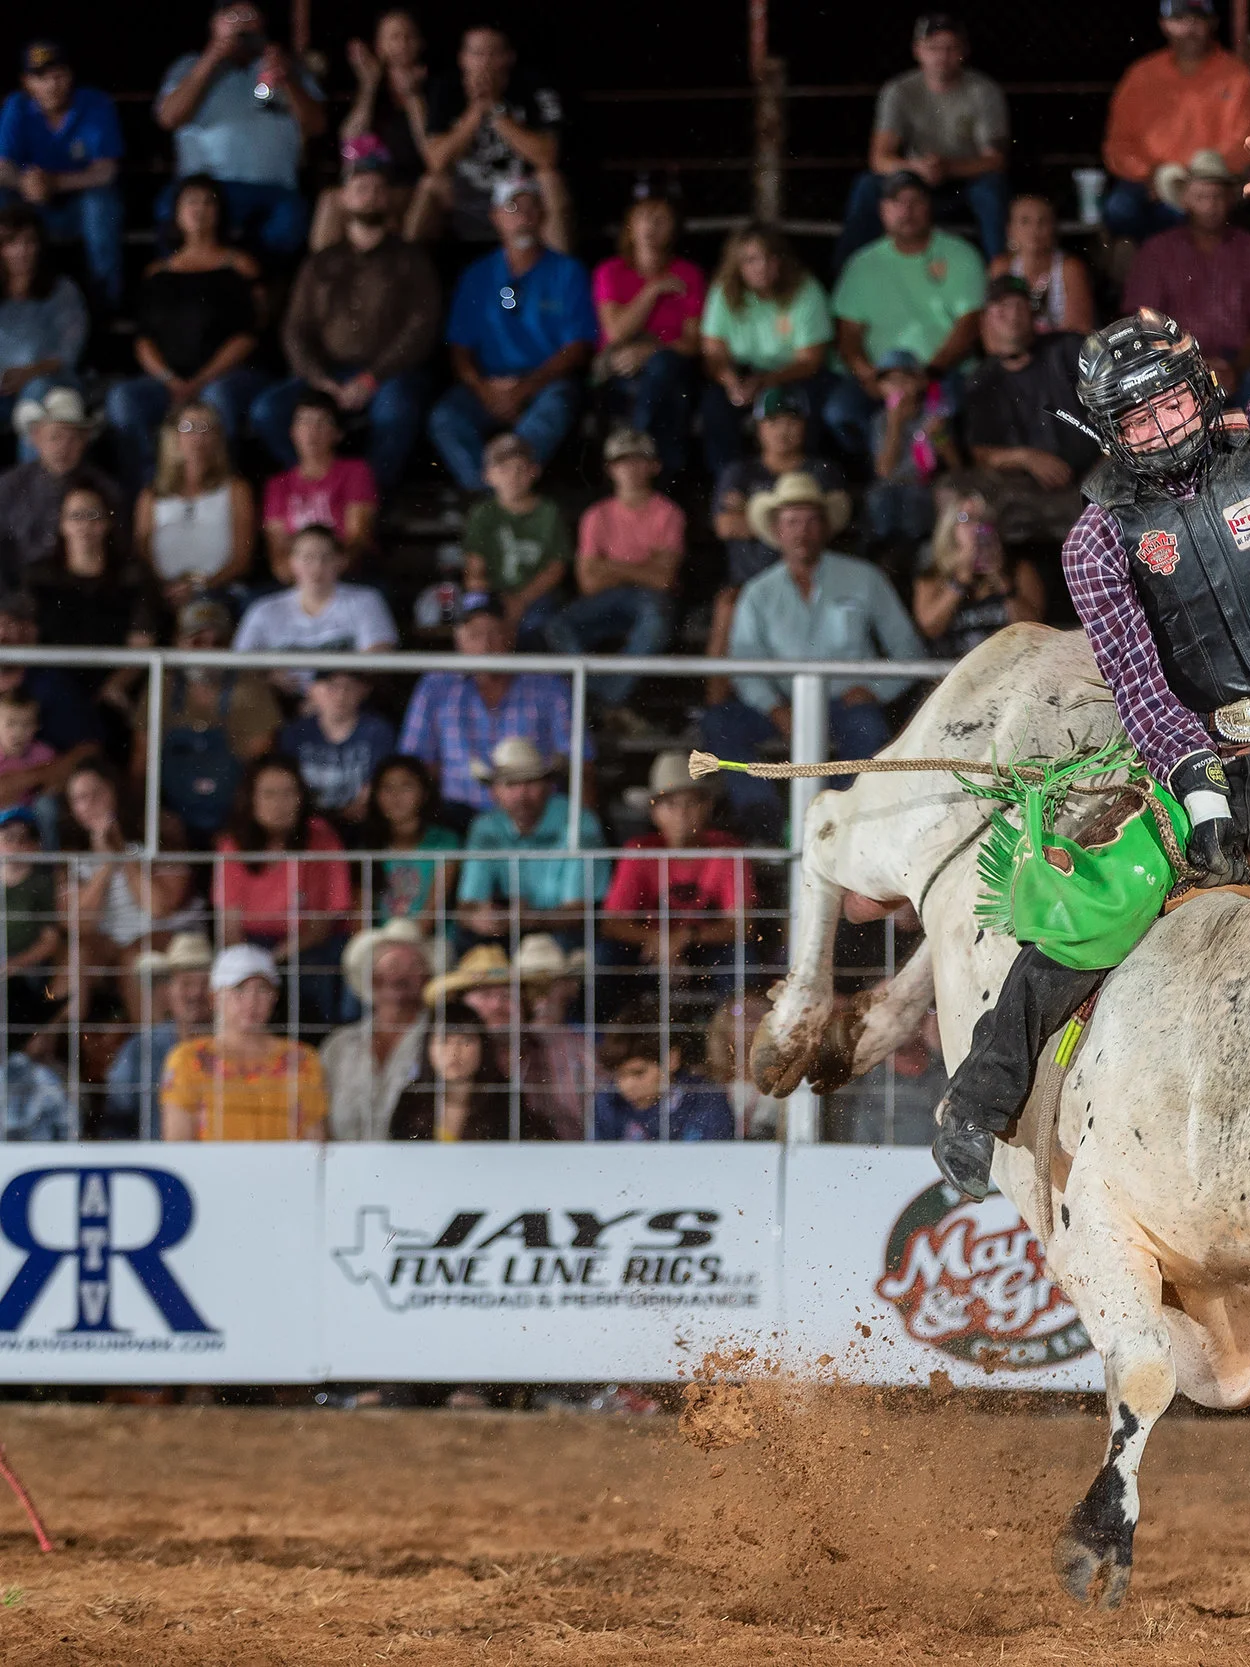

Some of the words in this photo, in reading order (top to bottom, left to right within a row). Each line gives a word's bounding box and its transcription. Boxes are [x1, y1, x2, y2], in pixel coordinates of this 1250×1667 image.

[1056, 409, 1080, 428] UNDER
[1139, 536, 1175, 559] FINALE
[394, 1211, 720, 1251] JAYS
[390, 1255, 490, 1286] FINE
[503, 1255, 611, 1286] LINE
[620, 1255, 722, 1286] RIGS
[911, 1286, 977, 1339] &
[971, 1261, 1060, 1334] Gr
